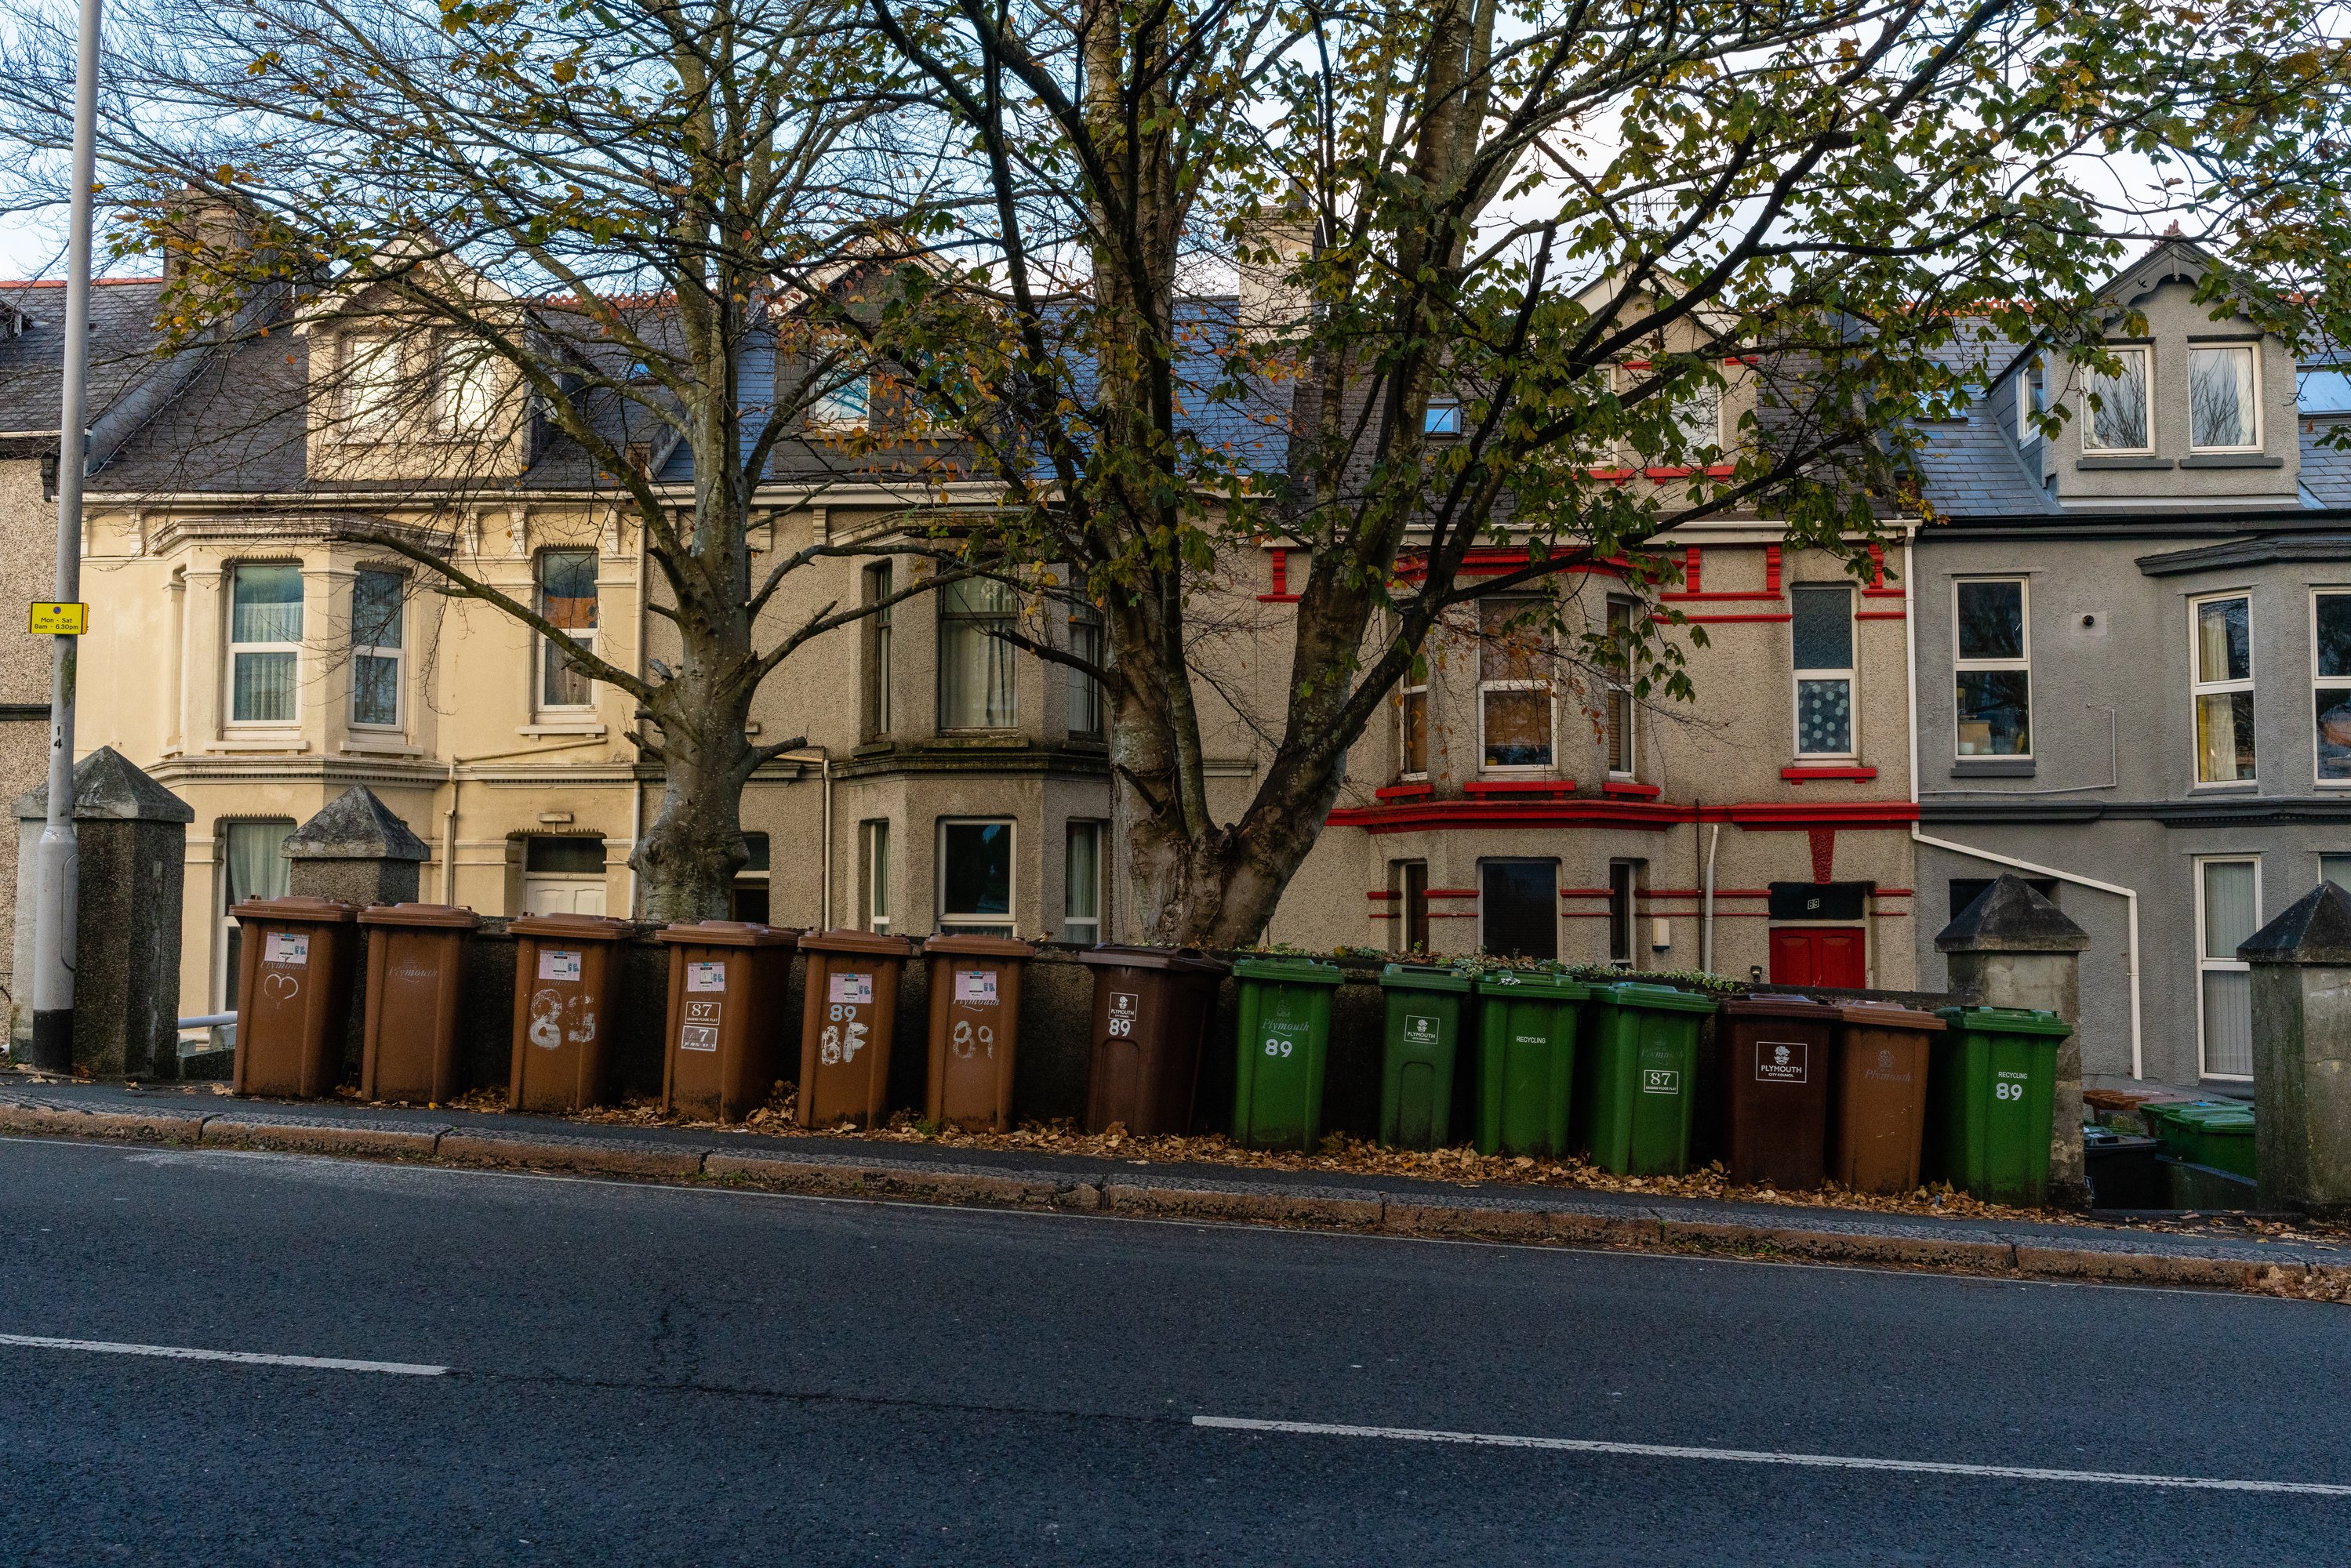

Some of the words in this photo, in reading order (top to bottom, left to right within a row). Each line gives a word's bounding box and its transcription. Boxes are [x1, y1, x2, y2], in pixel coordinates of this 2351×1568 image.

[1808, 899, 1819, 909] 89
[692, 1004, 712, 1016] 87
[830, 1004, 856, 1022] 89
[1109, 1018, 1131, 1036] 89
[1262, 1019, 1310, 1034] Plymouth
[954, 1021, 994, 1059] 89
[1516, 1036, 1546, 1044] RECYCLING
[1265, 1039, 1292, 1058] 89
[1761, 1065, 1802, 1073] PLYMOUTH
[1998, 1071, 2028, 1080] RECYCLING
[1651, 1072, 1671, 1086] 87
[1996, 1082, 2022, 1101] 89
